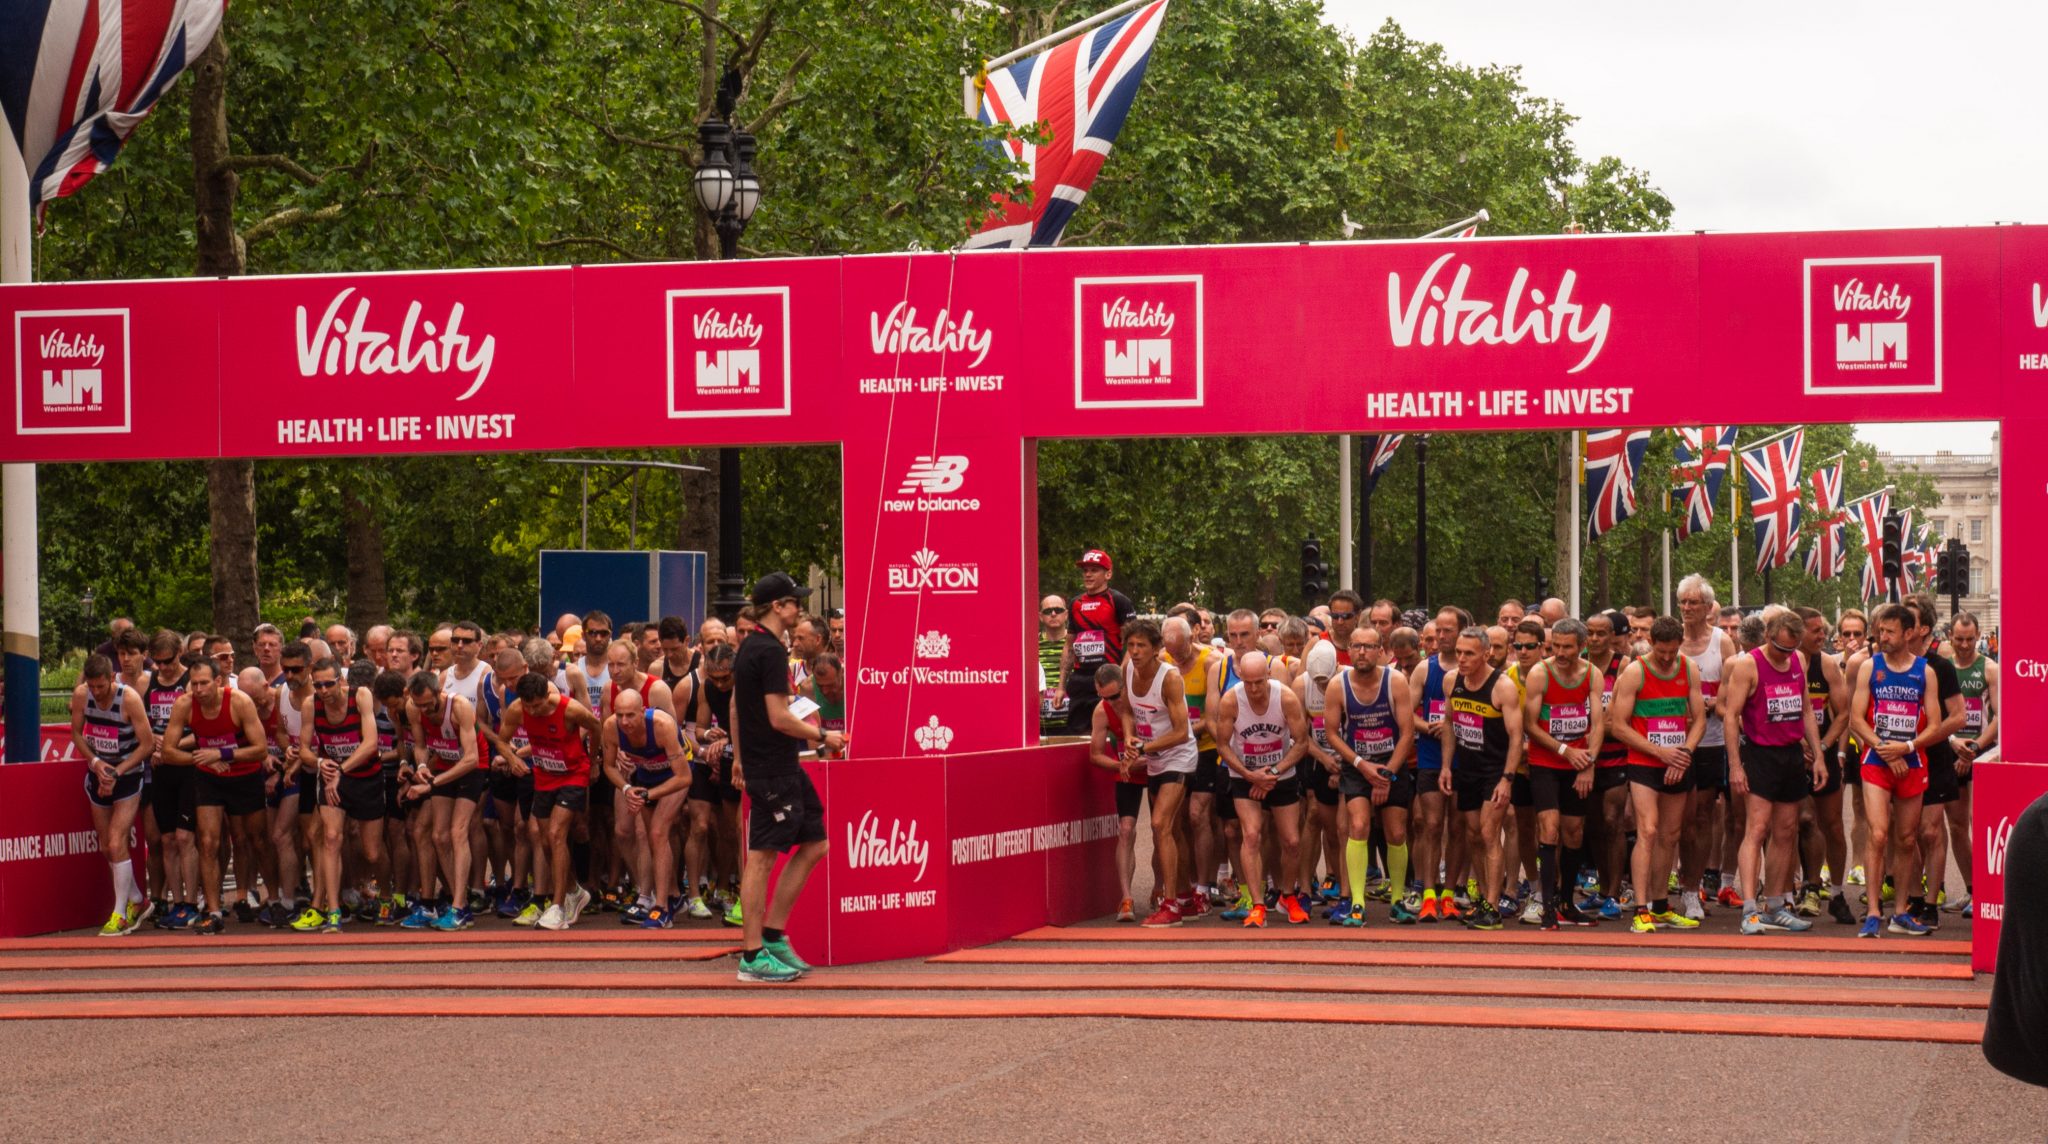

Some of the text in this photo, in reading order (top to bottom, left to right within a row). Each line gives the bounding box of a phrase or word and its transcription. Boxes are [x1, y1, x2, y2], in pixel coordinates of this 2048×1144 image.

[1833, 277, 1912, 320] Vitality
[1102, 296, 1175, 337] Vitality
[1388, 252, 1612, 373] Vitality
[693, 307, 763, 348] Vitality
[870, 300, 992, 369] Vitality
[40, 328, 105, 367] Vitality
[295, 286, 496, 401] Vitality
[1836, 322, 1908, 362] WM
[696, 349, 760, 387] WM
[1105, 339, 1172, 377] WM
[1837, 361, 1908, 370] Westminster Mile
[43, 369, 102, 404] WM
[696, 385, 760, 395] Westminster Mile
[859, 375, 1004, 394] HEALTH LIFE INVEST
[1105, 375, 1172, 385] Westminster Mile
[43, 404, 86, 412] Westminster
[1367, 387, 1634, 419] HEALTH LIFE INVEST
[277, 413, 516, 444] HEALTH LIFE INVEST
[884, 496, 981, 512] new balance
[888, 567, 979, 589] BUXTON
[1083, 643, 1104, 653] 16075
[858, 666, 1010, 689] City of Westminster
[1774, 684, 1793, 696] Vitality
[1875, 685, 1919, 695] HASTINGS
[1454, 699, 1488, 714] nym.ac
[1780, 699, 1801, 709] 16102
[1886, 703, 1908, 713] Vitality
[1657, 719, 1679, 731] Vitality
[1890, 717, 1915, 728] 16108
[1663, 734, 1685, 745] 16091
[1257, 752, 1282, 764] 16181
[44, 833, 66, 857] AND
[847, 809, 929, 883] Vitality
[952, 833, 995, 866] POSITIVELY
[995, 828, 1033, 858] DIFFERENT
[1033, 822, 1070, 852] INSURANCE
[1070, 819, 1082, 844] AND
[840, 890, 937, 913] HEALTH LIFE INVEST
[1980, 902, 2005, 921] HEALT
